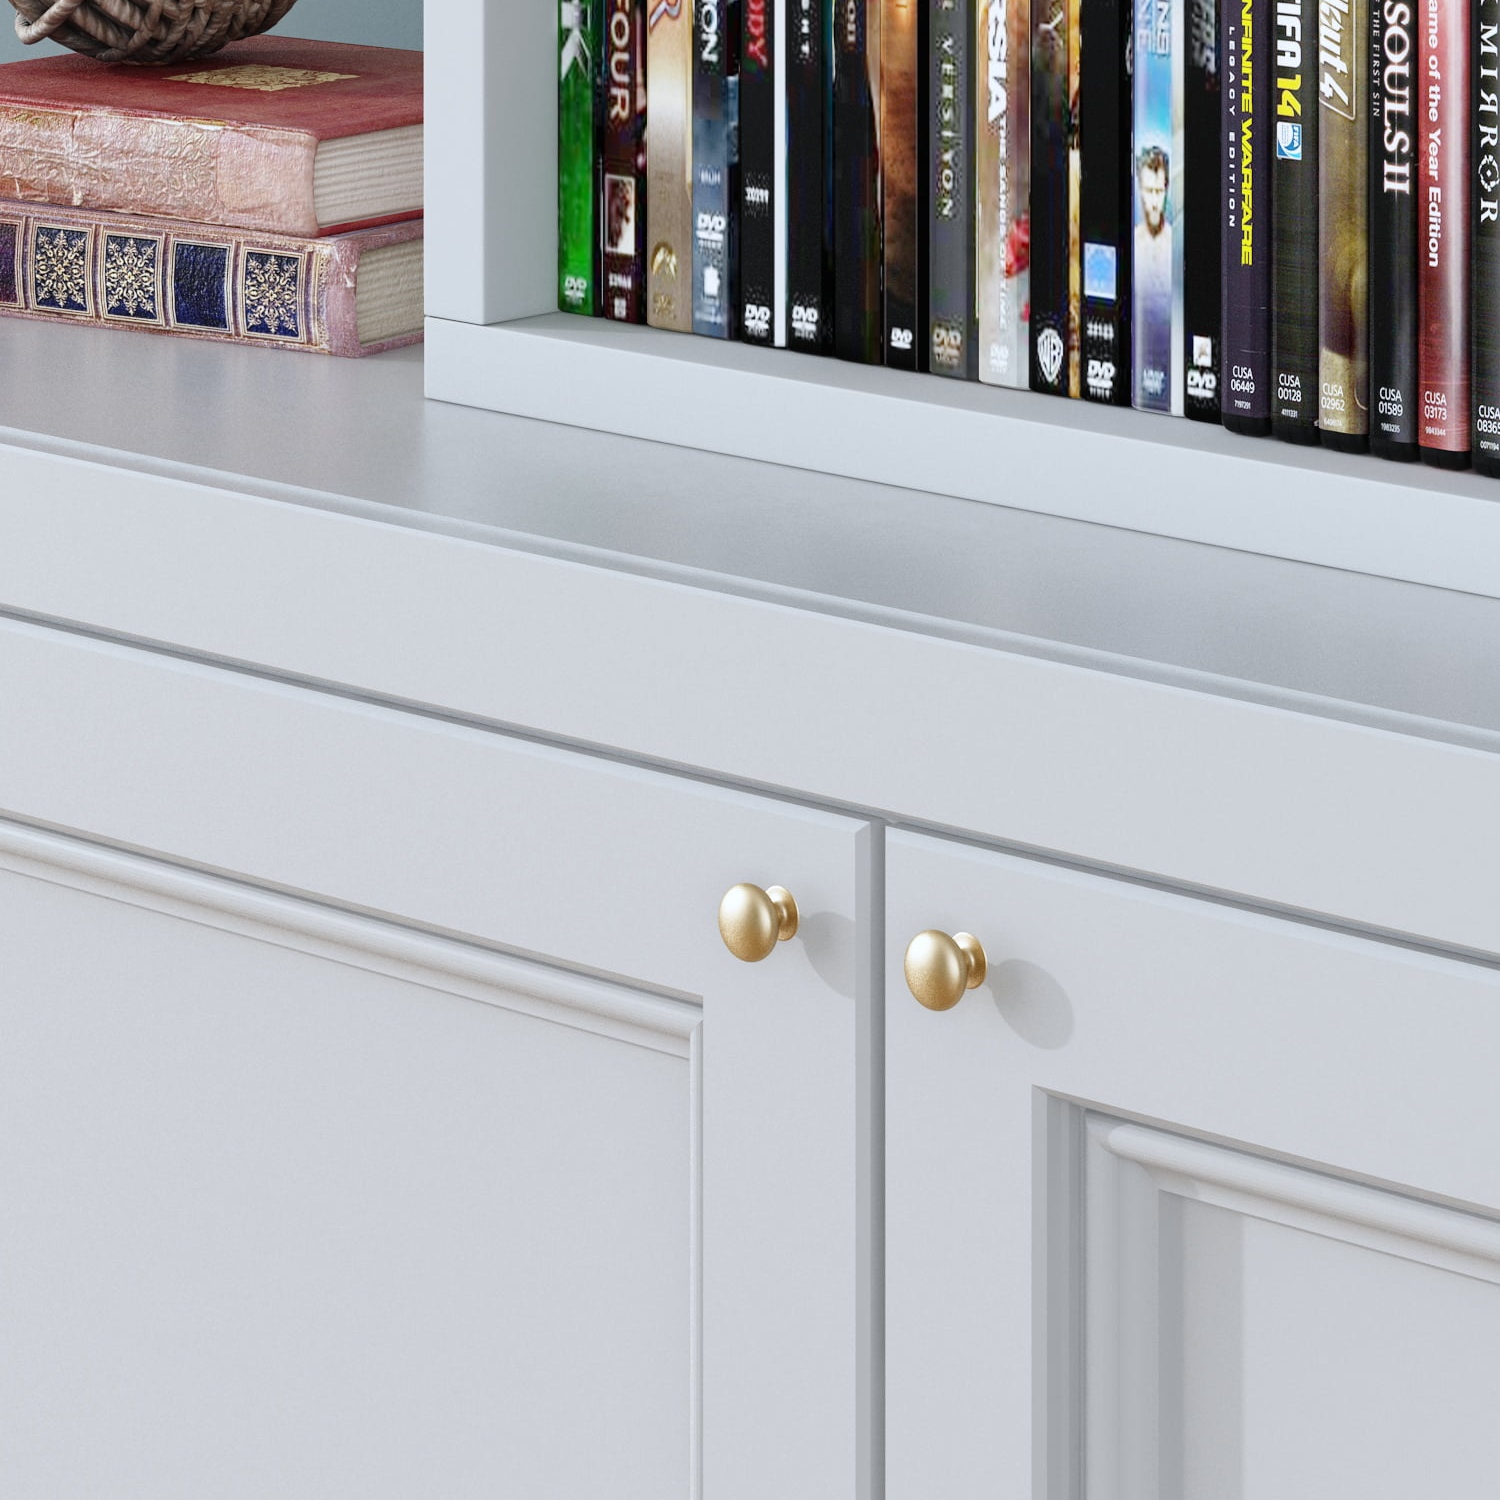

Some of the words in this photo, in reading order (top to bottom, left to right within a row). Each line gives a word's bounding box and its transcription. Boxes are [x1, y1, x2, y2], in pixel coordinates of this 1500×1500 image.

[1372, 10, 1380, 37] THE
[1228, 26, 1236, 116] LEGACY
[1372, 43, 1380, 87] FIRST
[1384, 0, 1411, 155] SOULS
[1428, 57, 1441, 80] of
[1276, 74, 1302, 117] 14
[1319, 72, 1349, 106] 4
[1372, 92, 1380, 117] SIN
[1428, 85, 1441, 122] the
[1428, 128, 1441, 181] Year
[1228, 131, 1236, 227] EDITION
[1383, 159, 1410, 196] II
[1241, 117, 1253, 266] WARFARE
[1428, 187, 1441, 268] Edition
[1232, 365, 1254, 380] CUSA
[1278, 373, 1301, 388] CUSA
[1230, 379, 1255, 394] 06449
[1277, 387, 1302, 403] 00128
[1322, 382, 1344, 398] CUSA
[1379, 387, 1402, 402] CUSA
[1424, 390, 1447, 406] CUSA
[1321, 396, 1345, 412] 02962
[1378, 401, 1403, 417] 01589
[1478, 404, 1500, 420] CUSA
